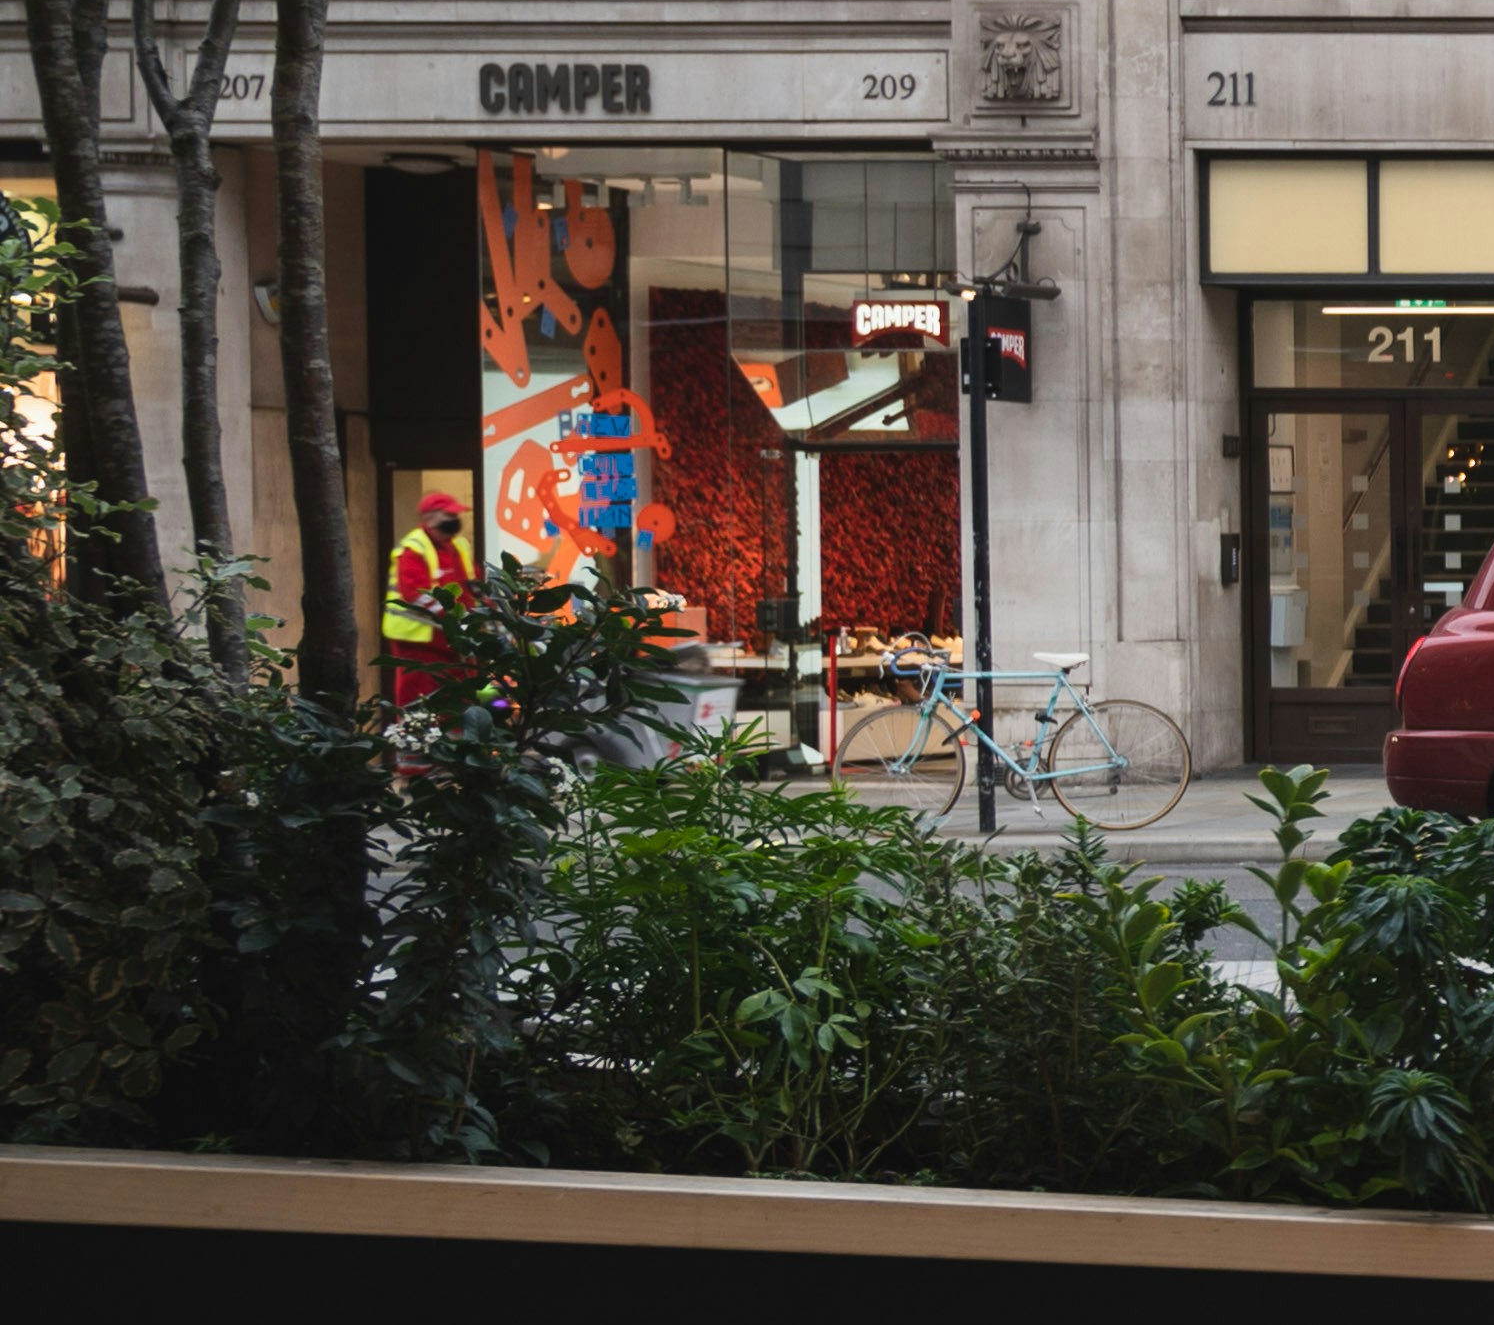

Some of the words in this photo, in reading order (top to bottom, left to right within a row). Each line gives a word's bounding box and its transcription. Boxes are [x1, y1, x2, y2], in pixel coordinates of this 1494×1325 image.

[218, 73, 265, 101] 207
[479, 61, 651, 114] CAMPER
[862, 73, 917, 100] 209
[1206, 70, 1257, 107] 211
[855, 303, 941, 336] CAMPER
[1367, 325, 1442, 363] 211
